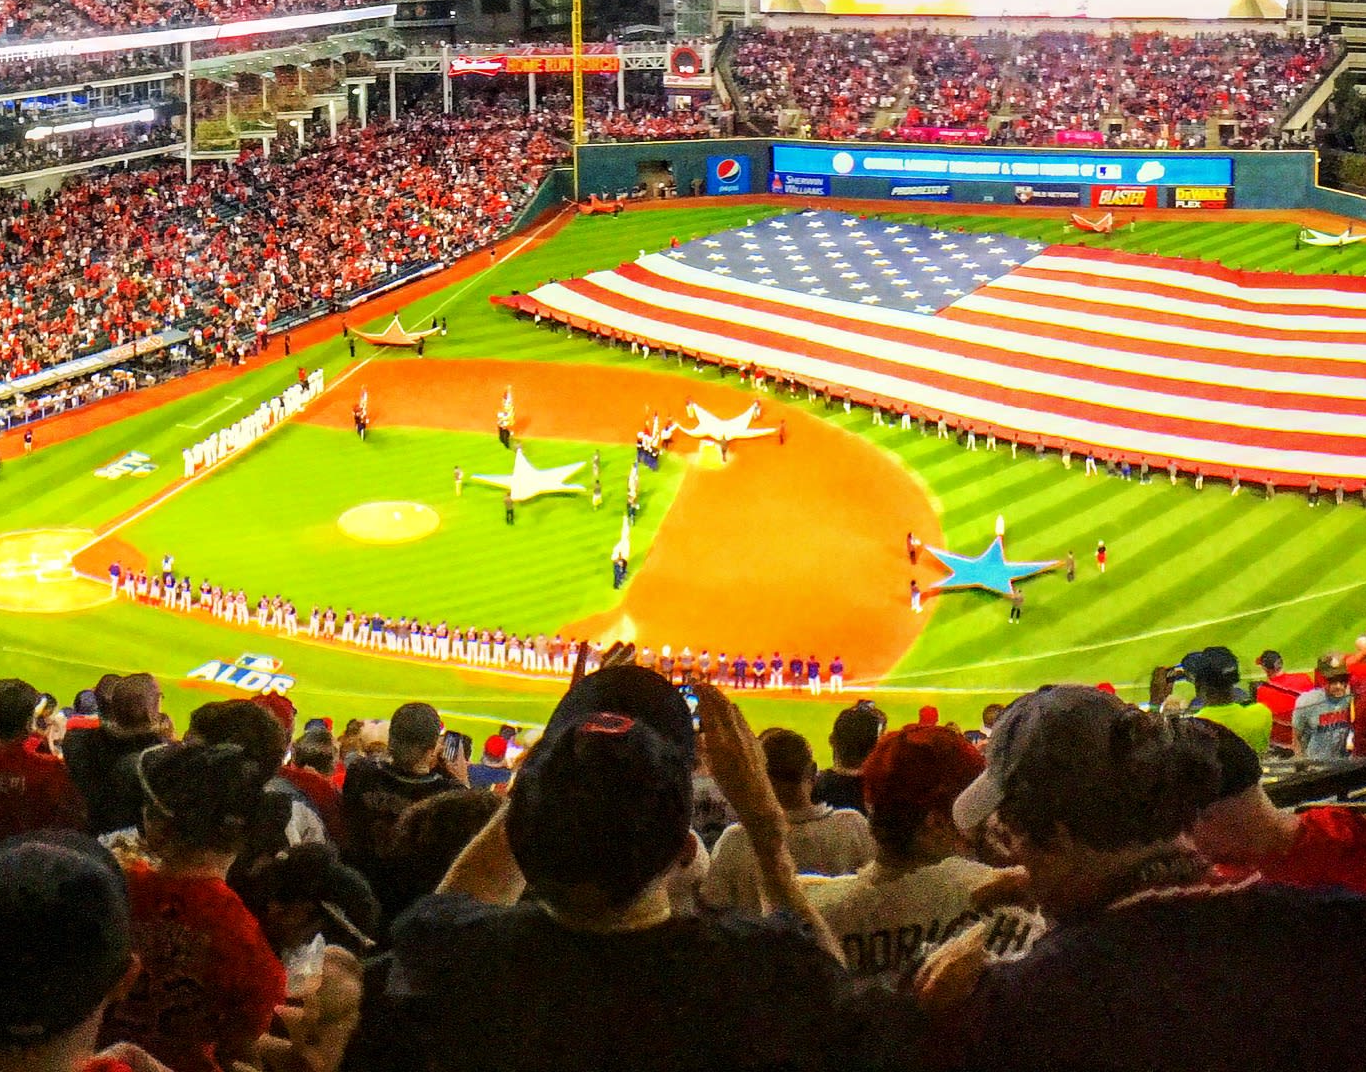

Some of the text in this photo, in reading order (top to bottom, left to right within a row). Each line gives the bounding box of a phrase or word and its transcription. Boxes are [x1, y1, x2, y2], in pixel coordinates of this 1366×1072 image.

[785, 175, 824, 186] SHERWIN
[784, 185, 825, 195] WILLIAMS
[1098, 189, 1147, 206] BLASTER
[186, 659, 296, 696] ALDS
